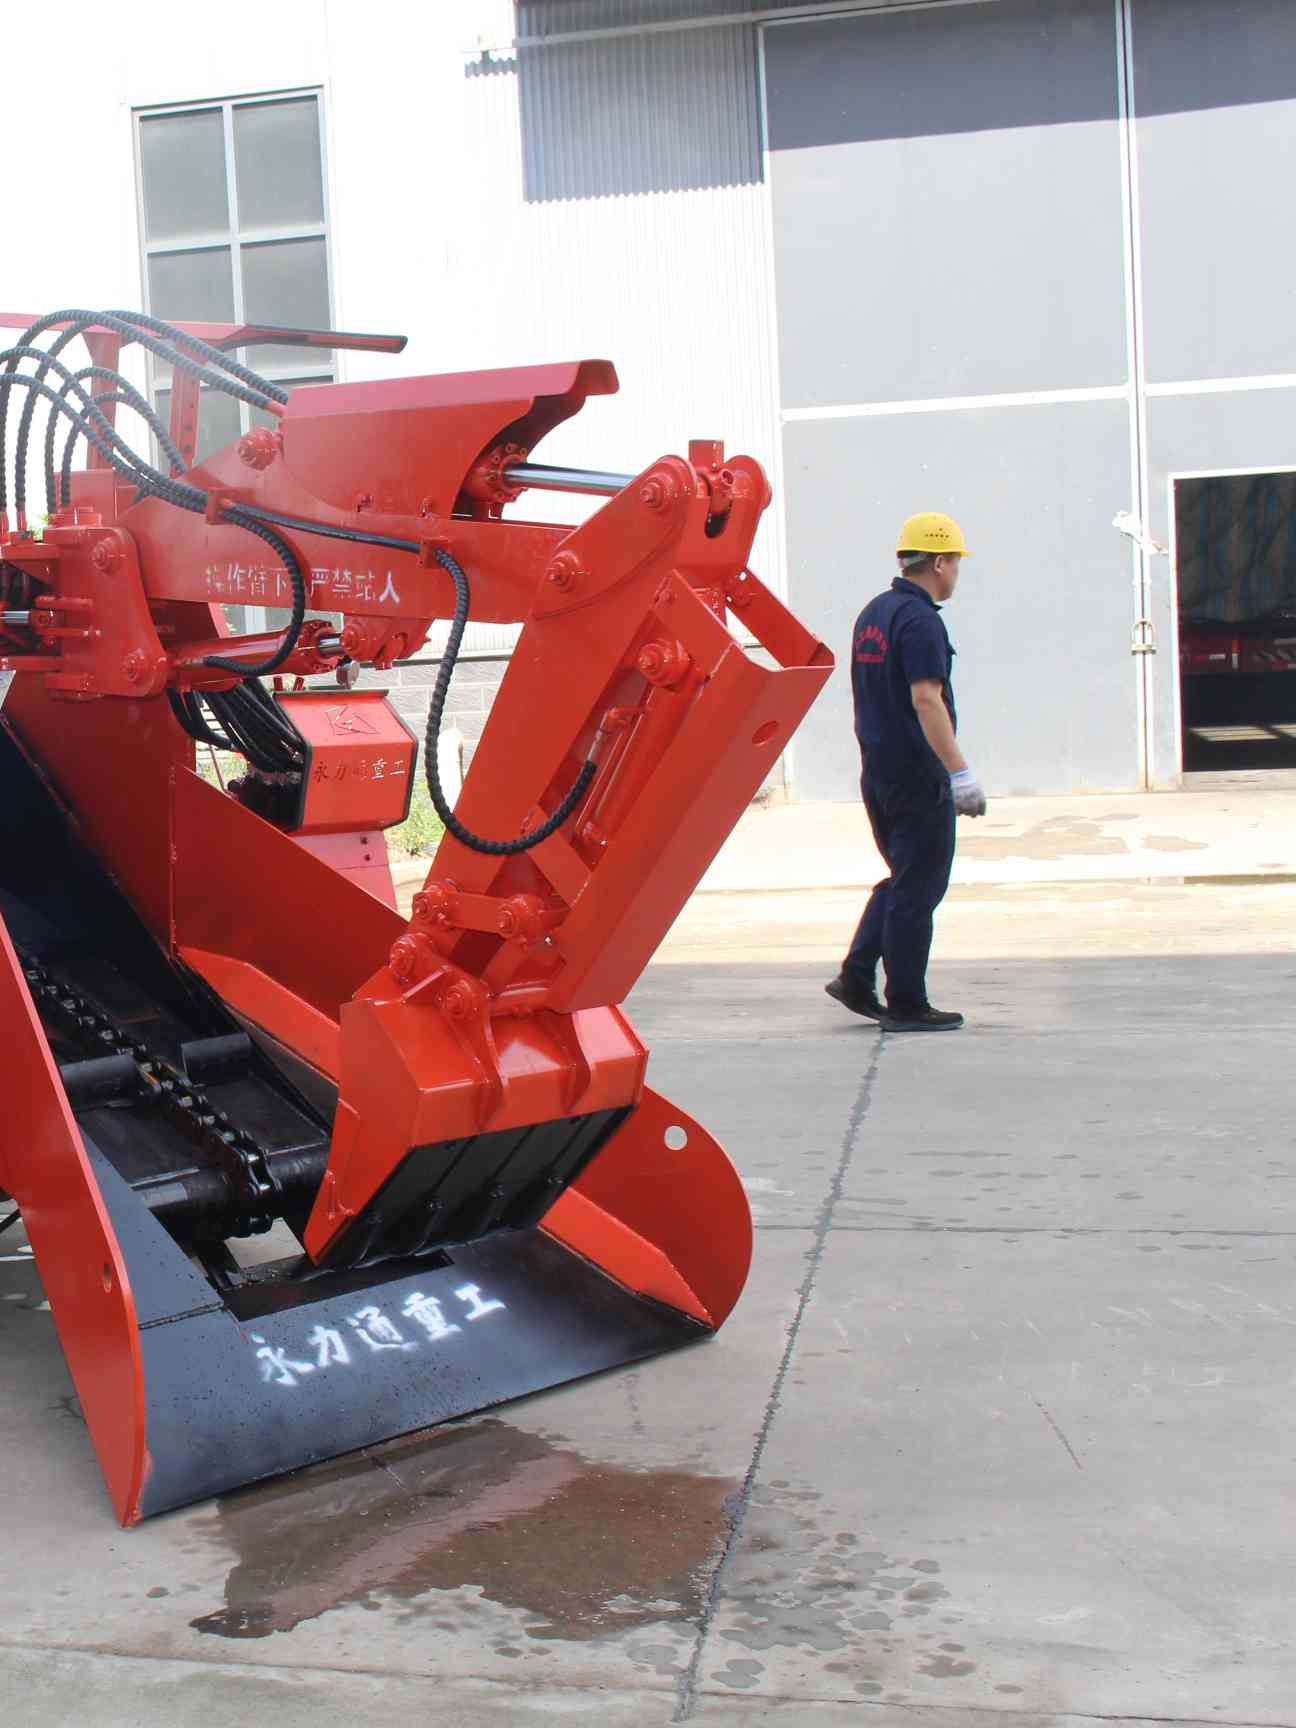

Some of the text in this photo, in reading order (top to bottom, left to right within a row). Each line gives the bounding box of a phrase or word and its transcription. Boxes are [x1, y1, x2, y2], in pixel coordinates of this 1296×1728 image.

[250, 1282, 507, 1387] 永力通重工
